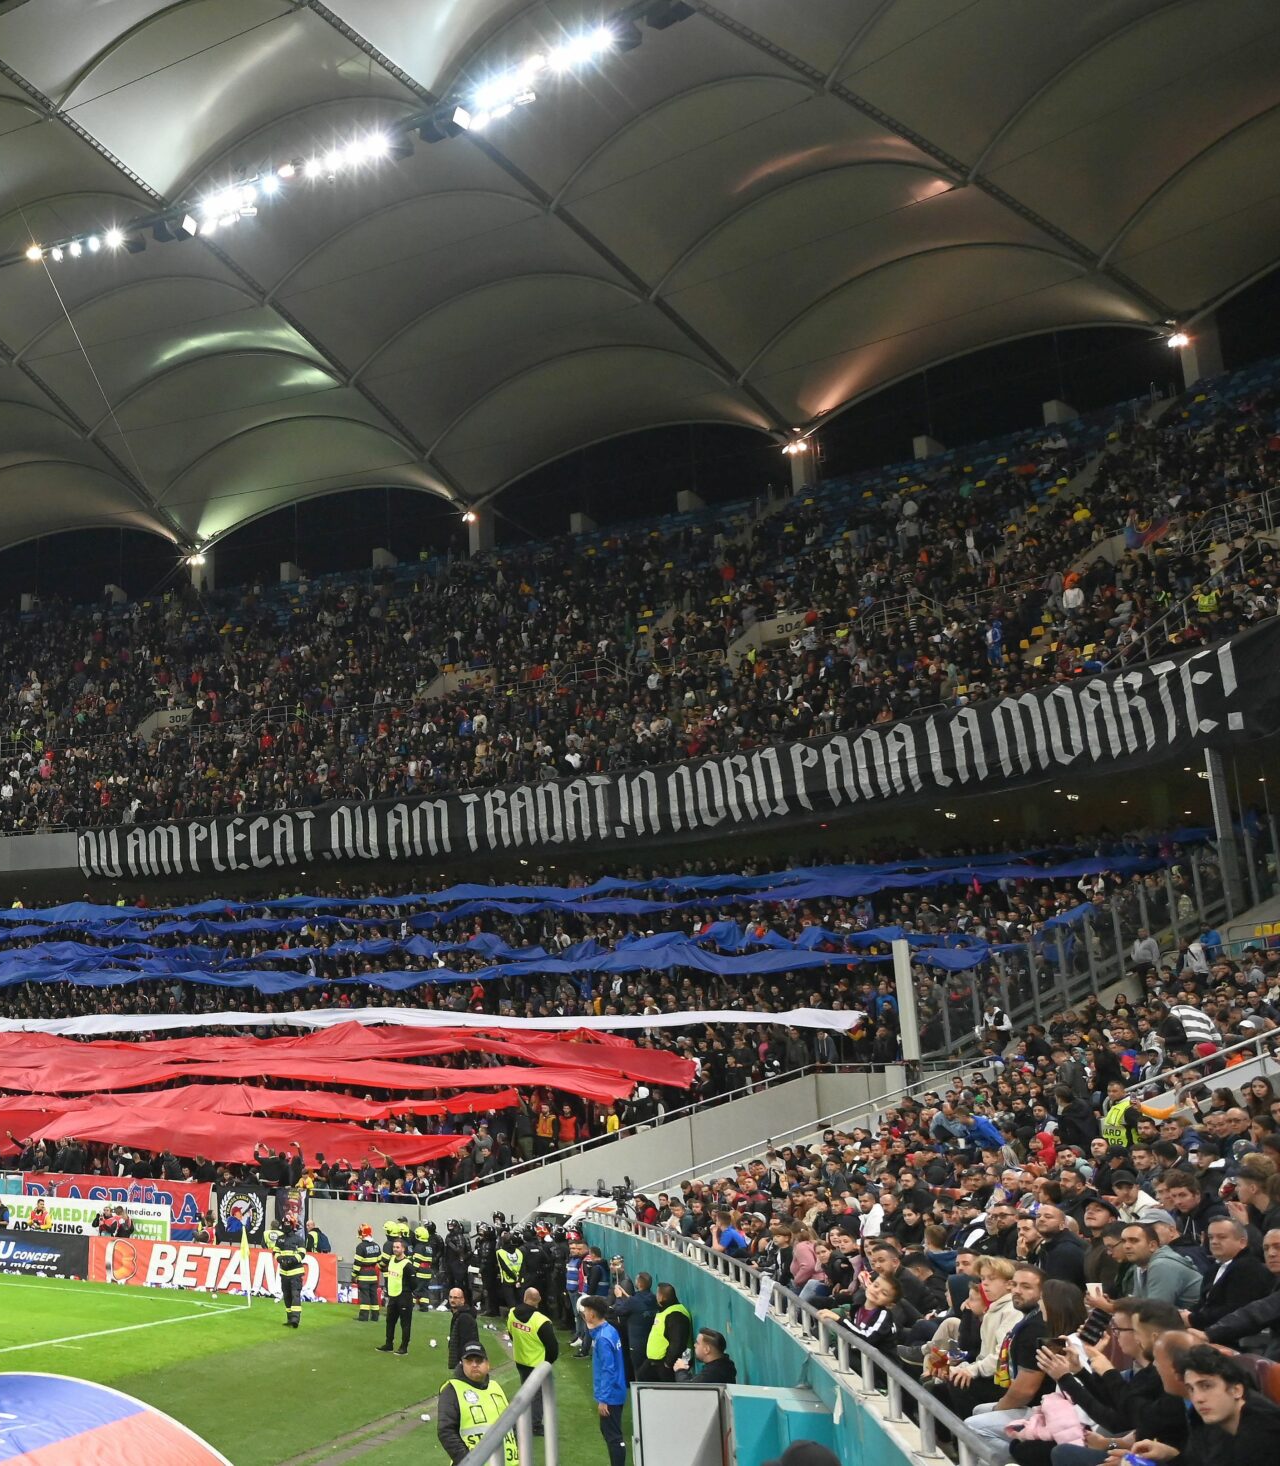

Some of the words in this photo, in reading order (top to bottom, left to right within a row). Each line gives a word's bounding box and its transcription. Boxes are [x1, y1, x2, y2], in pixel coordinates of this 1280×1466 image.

[127, 824, 183, 876] AM
[386, 798, 452, 860] AM
[667, 746, 790, 833] NORD
[790, 722, 923, 811] PANA
[925, 706, 989, 788] LA
[991, 641, 1245, 778] MOARTE!
[13, 1251, 61, 1263] CONCEPT
